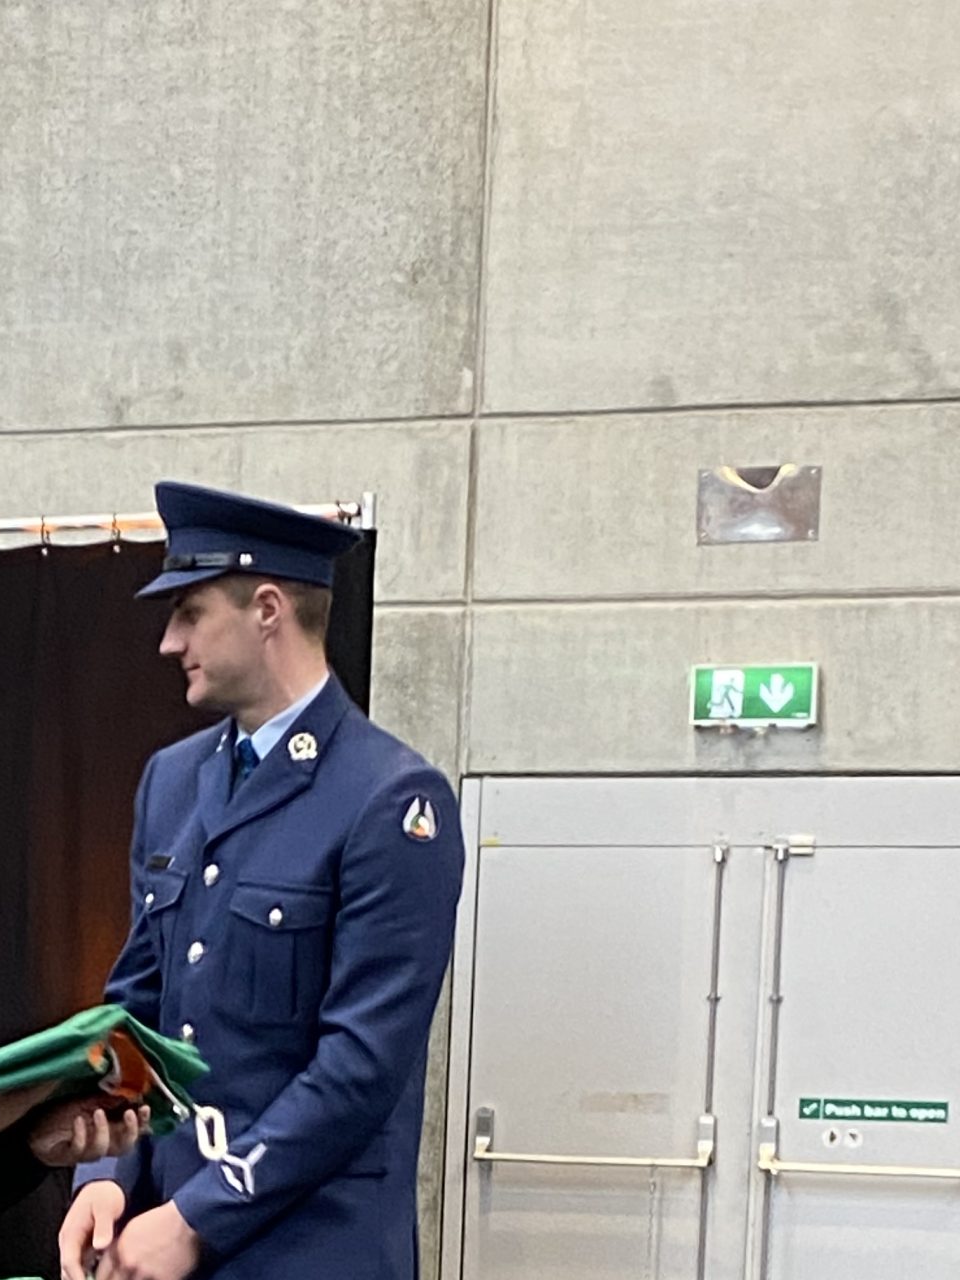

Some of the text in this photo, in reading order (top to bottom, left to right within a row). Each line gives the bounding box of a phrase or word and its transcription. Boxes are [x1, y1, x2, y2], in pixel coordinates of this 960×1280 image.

[824, 1103, 946, 1120] Push bar to open
